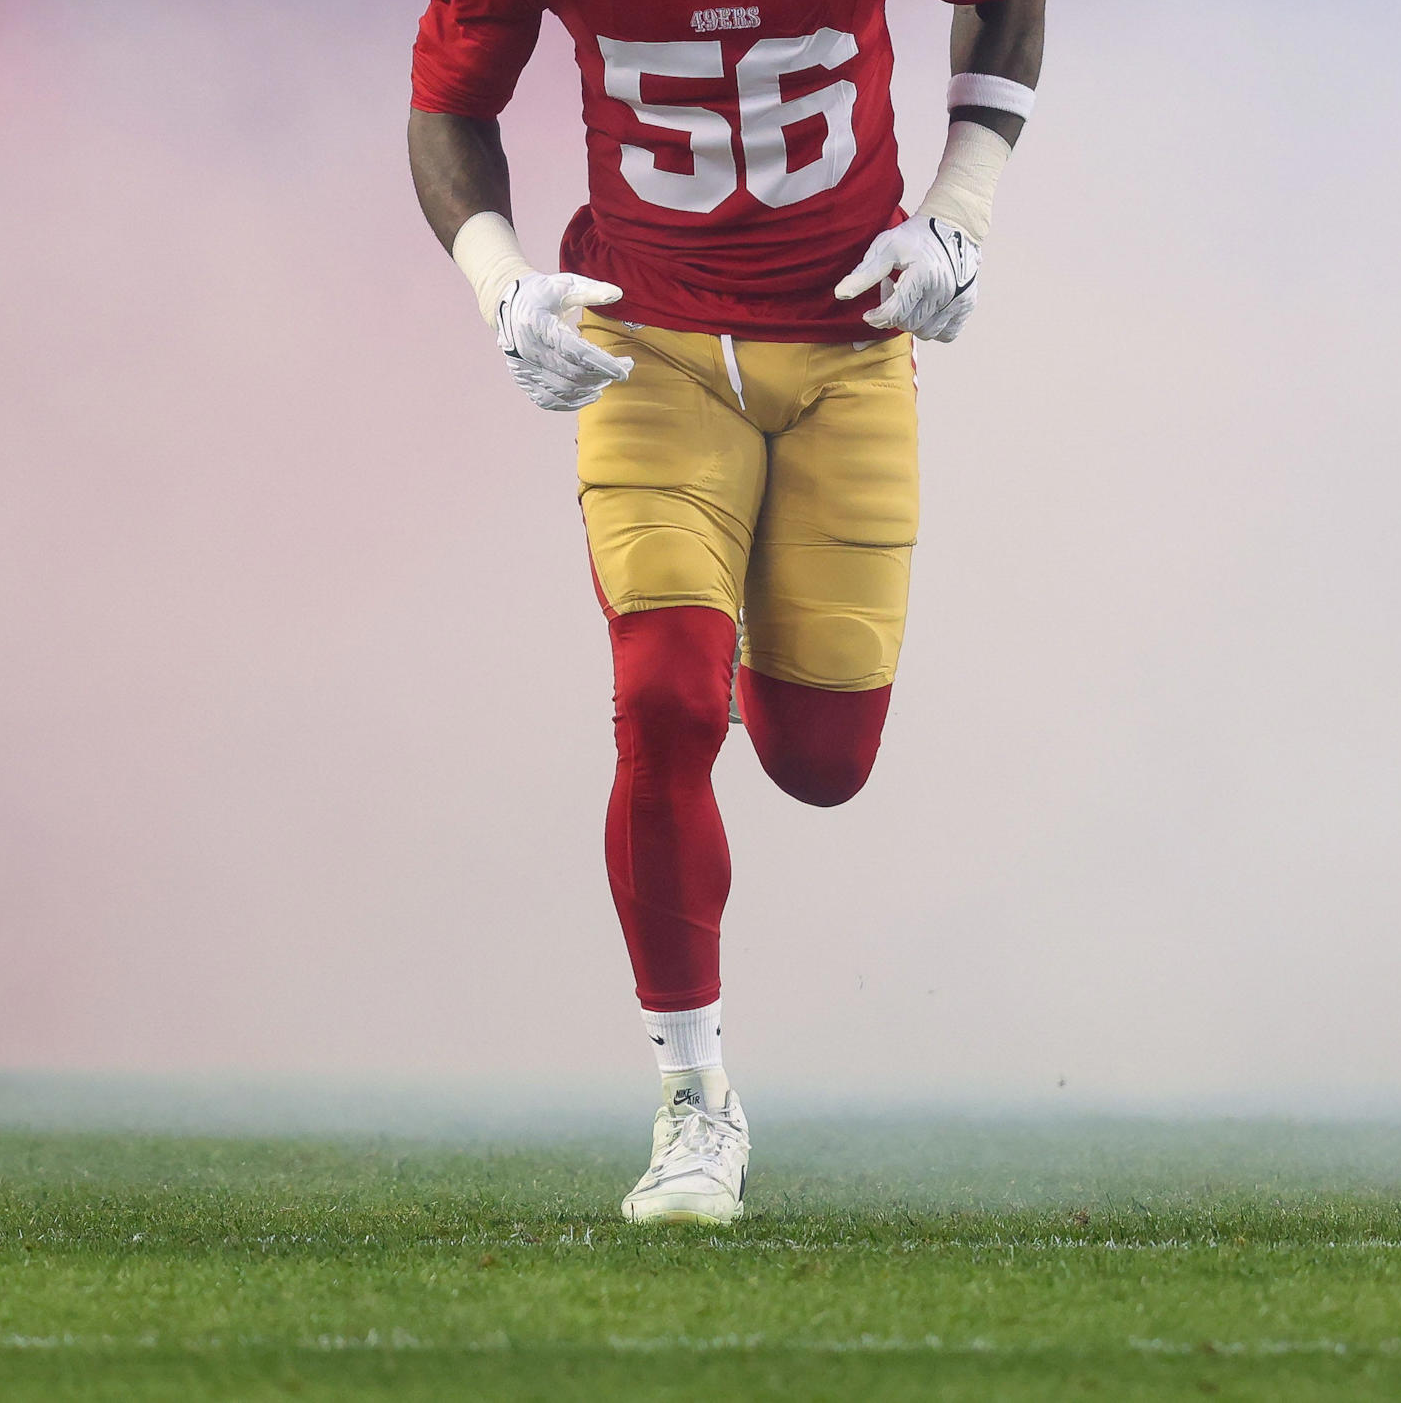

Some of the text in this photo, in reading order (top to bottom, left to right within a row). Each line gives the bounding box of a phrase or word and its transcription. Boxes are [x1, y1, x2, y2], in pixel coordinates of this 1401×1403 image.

[690, 6, 761, 32] 49ERS
[598, 27, 859, 214] 56
[676, 1088, 692, 1098] NIKE
[687, 1096, 700, 1105] AIR
